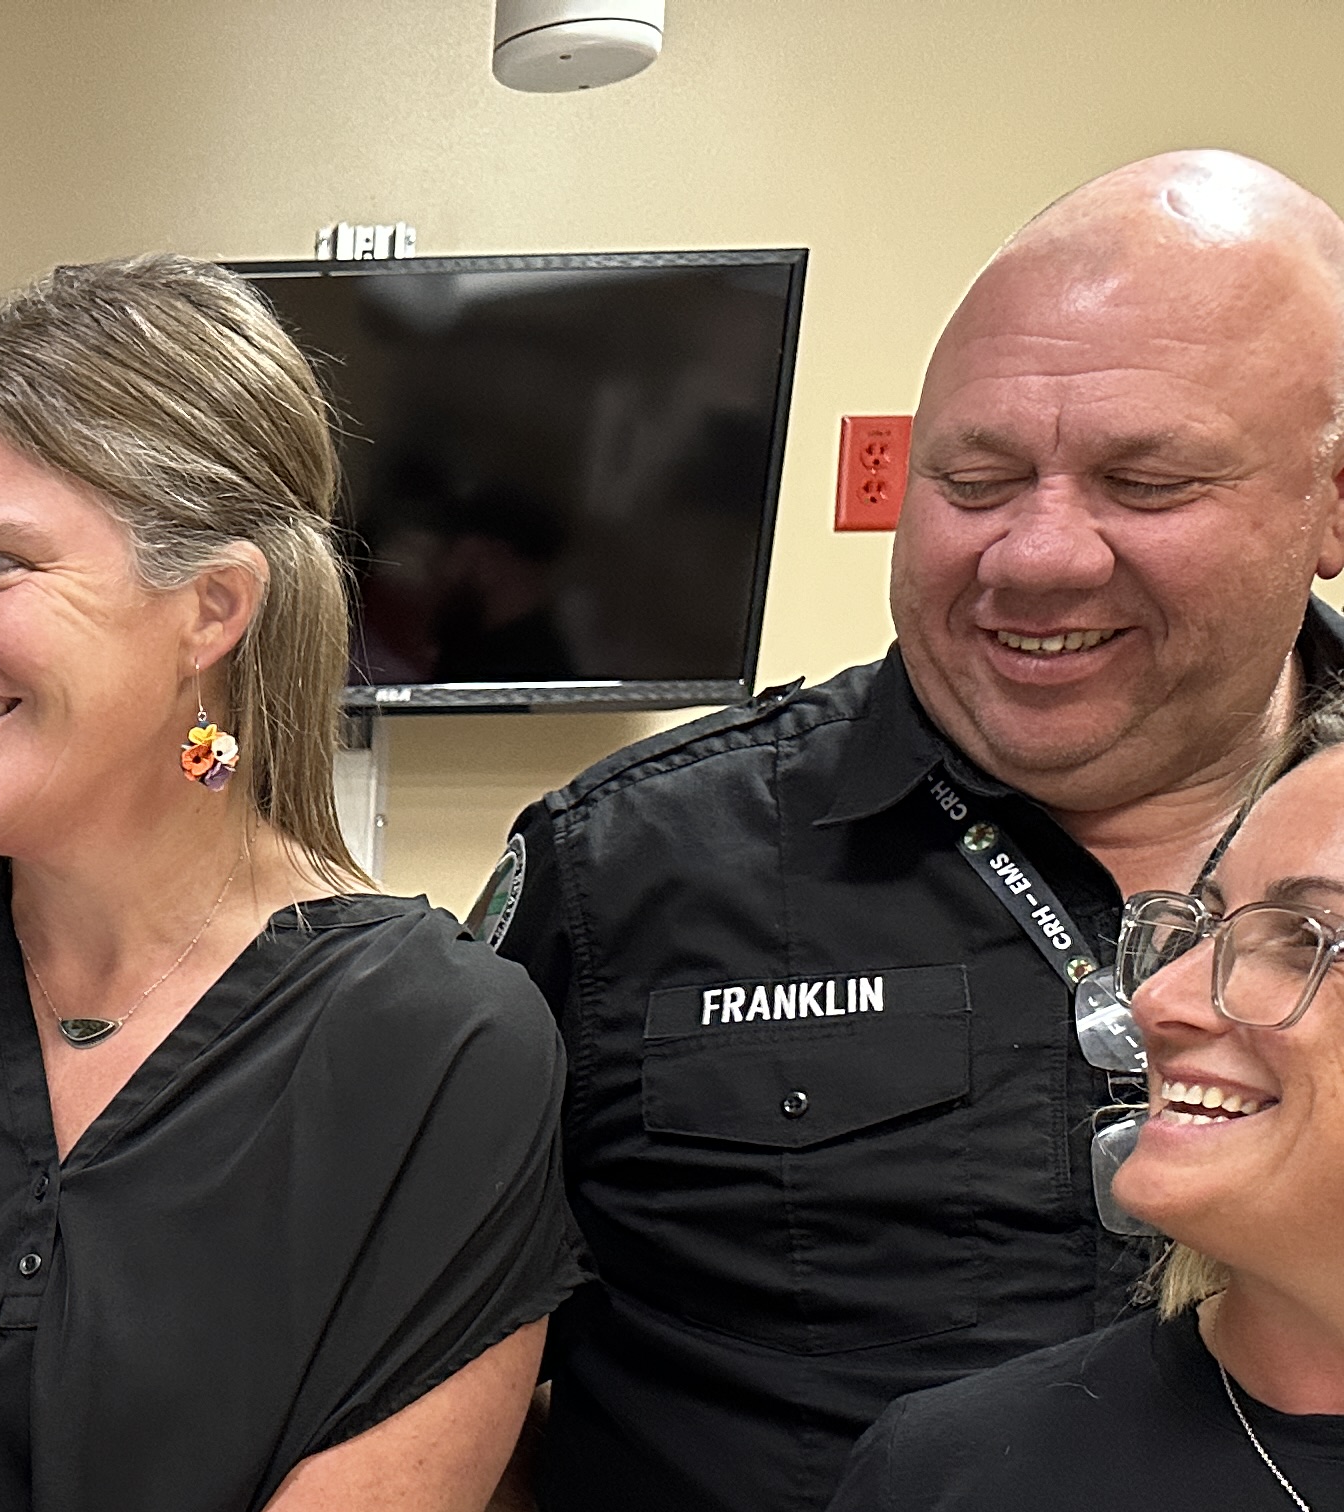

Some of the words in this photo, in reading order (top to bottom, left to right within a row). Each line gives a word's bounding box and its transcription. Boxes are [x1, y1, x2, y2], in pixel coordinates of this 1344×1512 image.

[989, 853, 1032, 895] EMS
[1031, 905, 1072, 950] CRH
[700, 975, 885, 1026] FRANKLIN
